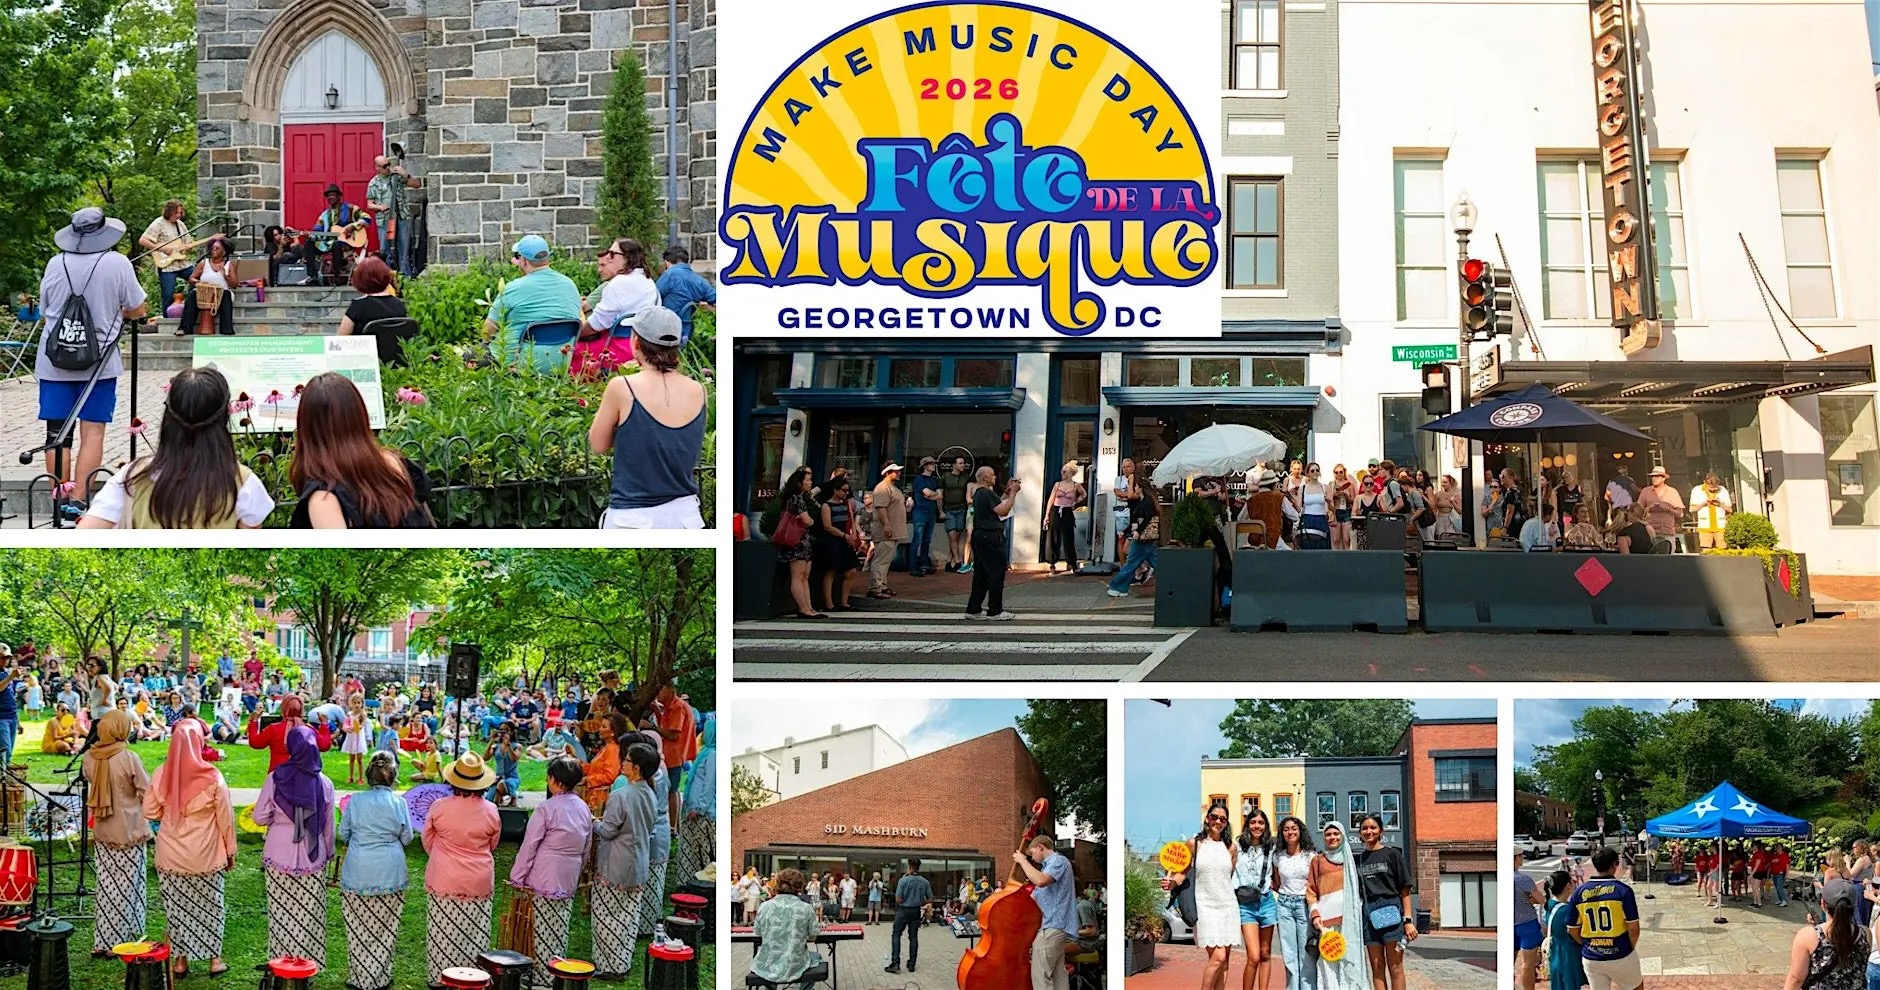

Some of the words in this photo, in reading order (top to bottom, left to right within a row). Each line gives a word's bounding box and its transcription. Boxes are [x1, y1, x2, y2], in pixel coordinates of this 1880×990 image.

[1396, 347, 1445, 359] Wisconsin
[824, 824, 847, 834] SID
[852, 826, 928, 838] MASHBURN
[1584, 905, 1613, 933] 10
